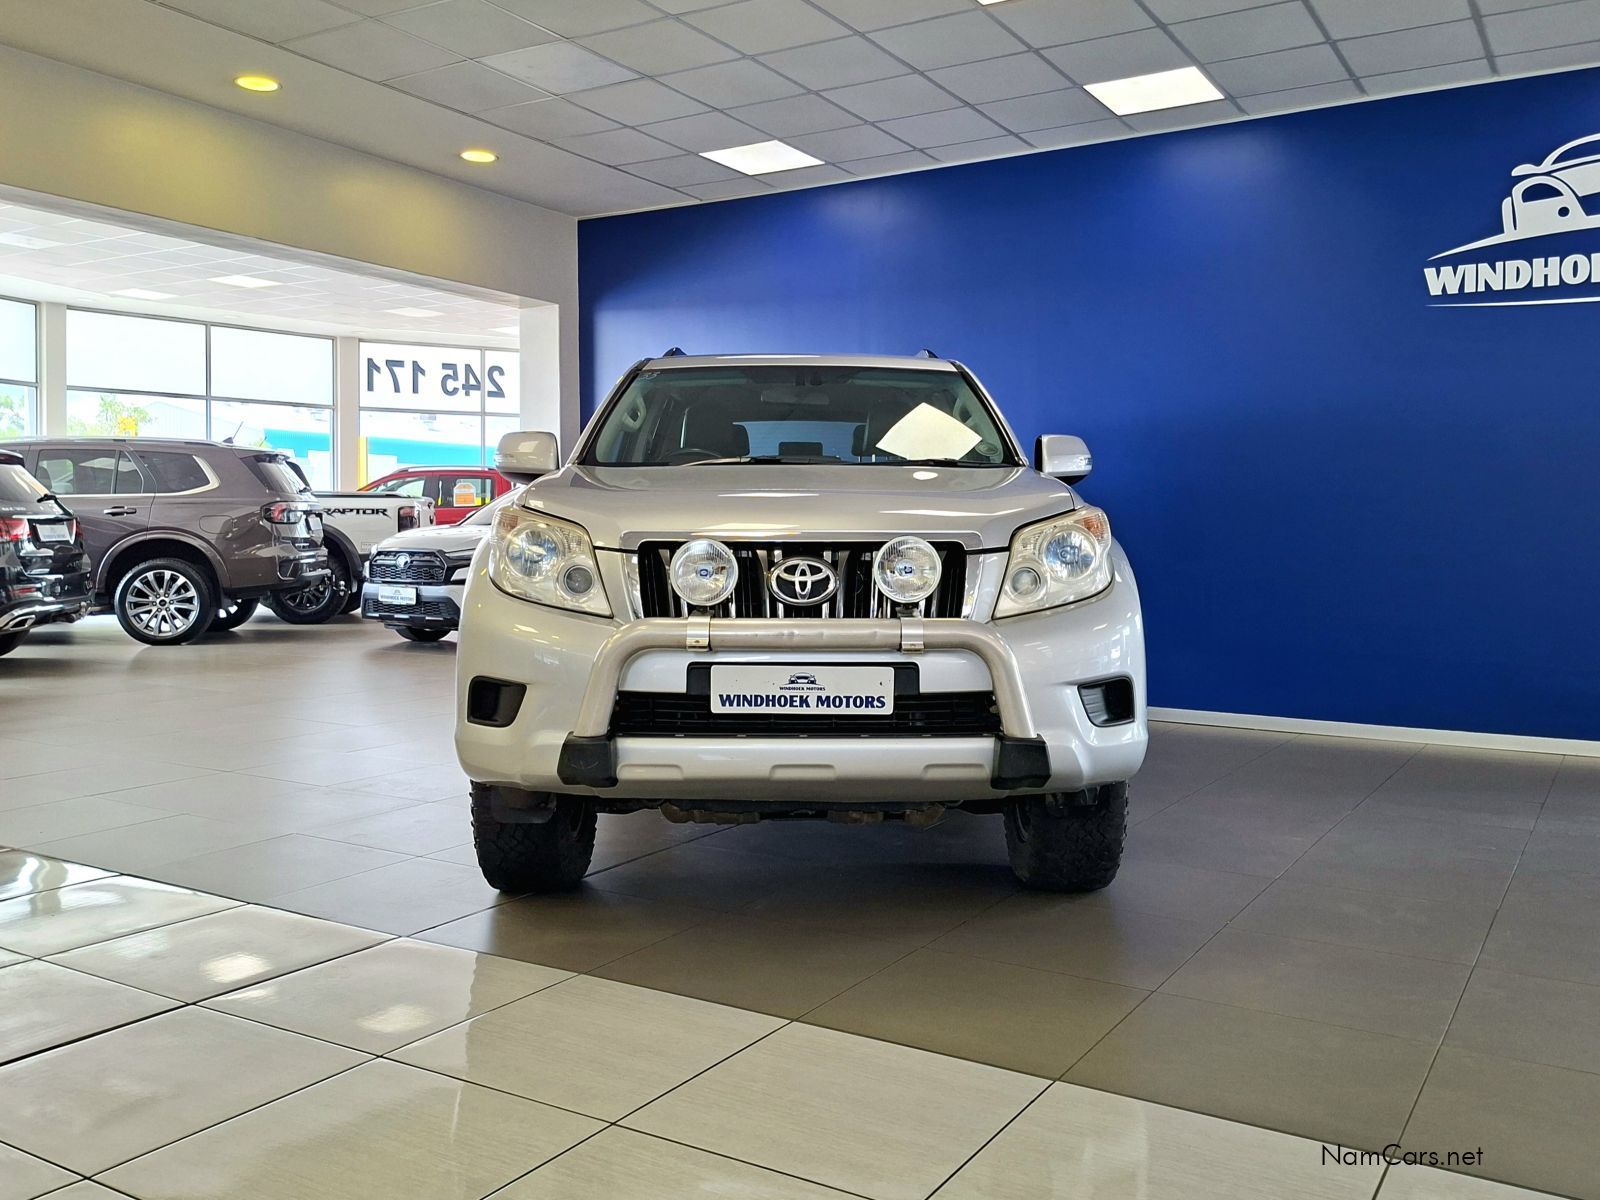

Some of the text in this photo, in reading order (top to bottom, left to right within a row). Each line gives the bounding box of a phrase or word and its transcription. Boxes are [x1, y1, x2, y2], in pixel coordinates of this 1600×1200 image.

[323, 507, 392, 519] RAPTOR
[718, 694, 886, 709] WINDHOEK MOTORS
